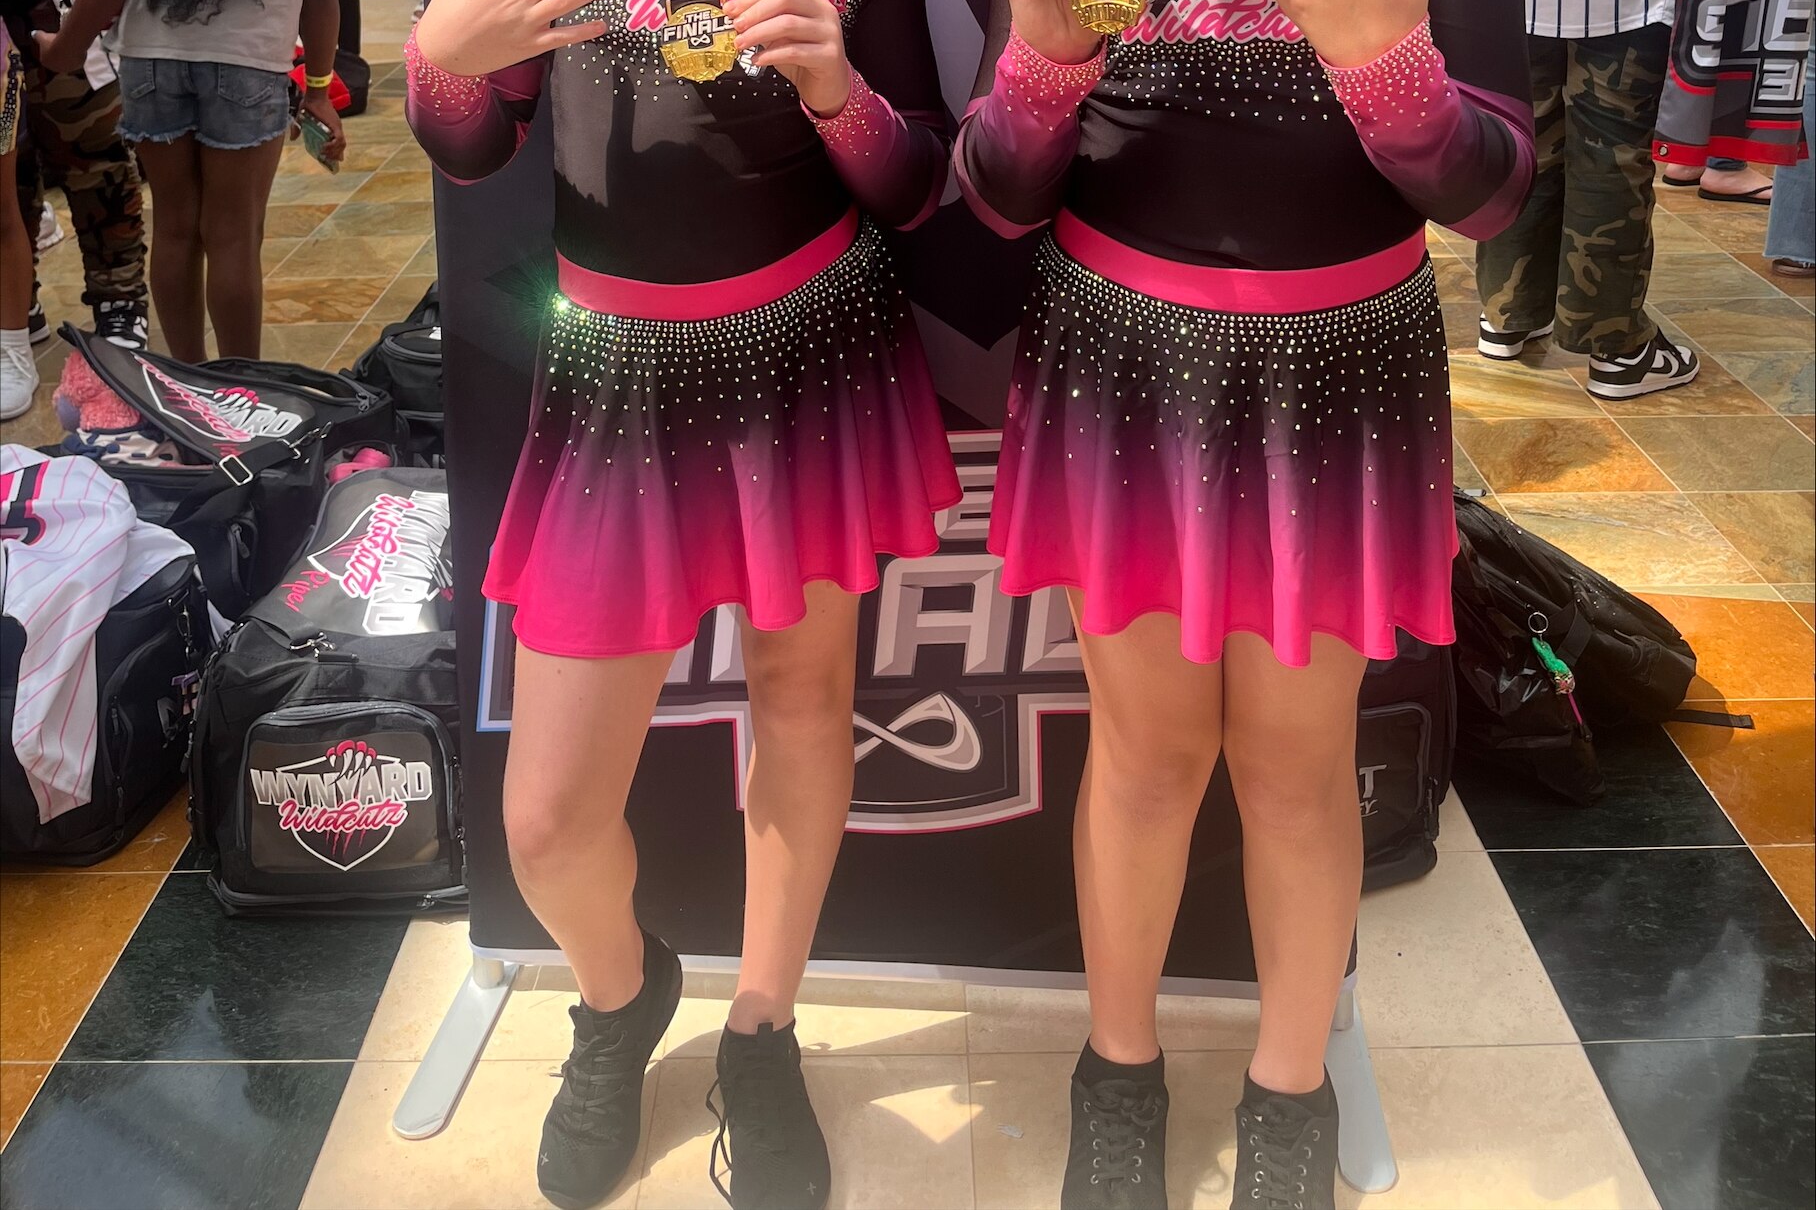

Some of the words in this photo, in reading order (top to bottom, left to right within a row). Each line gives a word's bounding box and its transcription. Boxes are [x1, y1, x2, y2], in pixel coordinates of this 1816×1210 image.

[686, 11, 711, 23] THE
[250, 761, 432, 809] WYNYARD
[278, 797, 408, 833] Wildcatz
